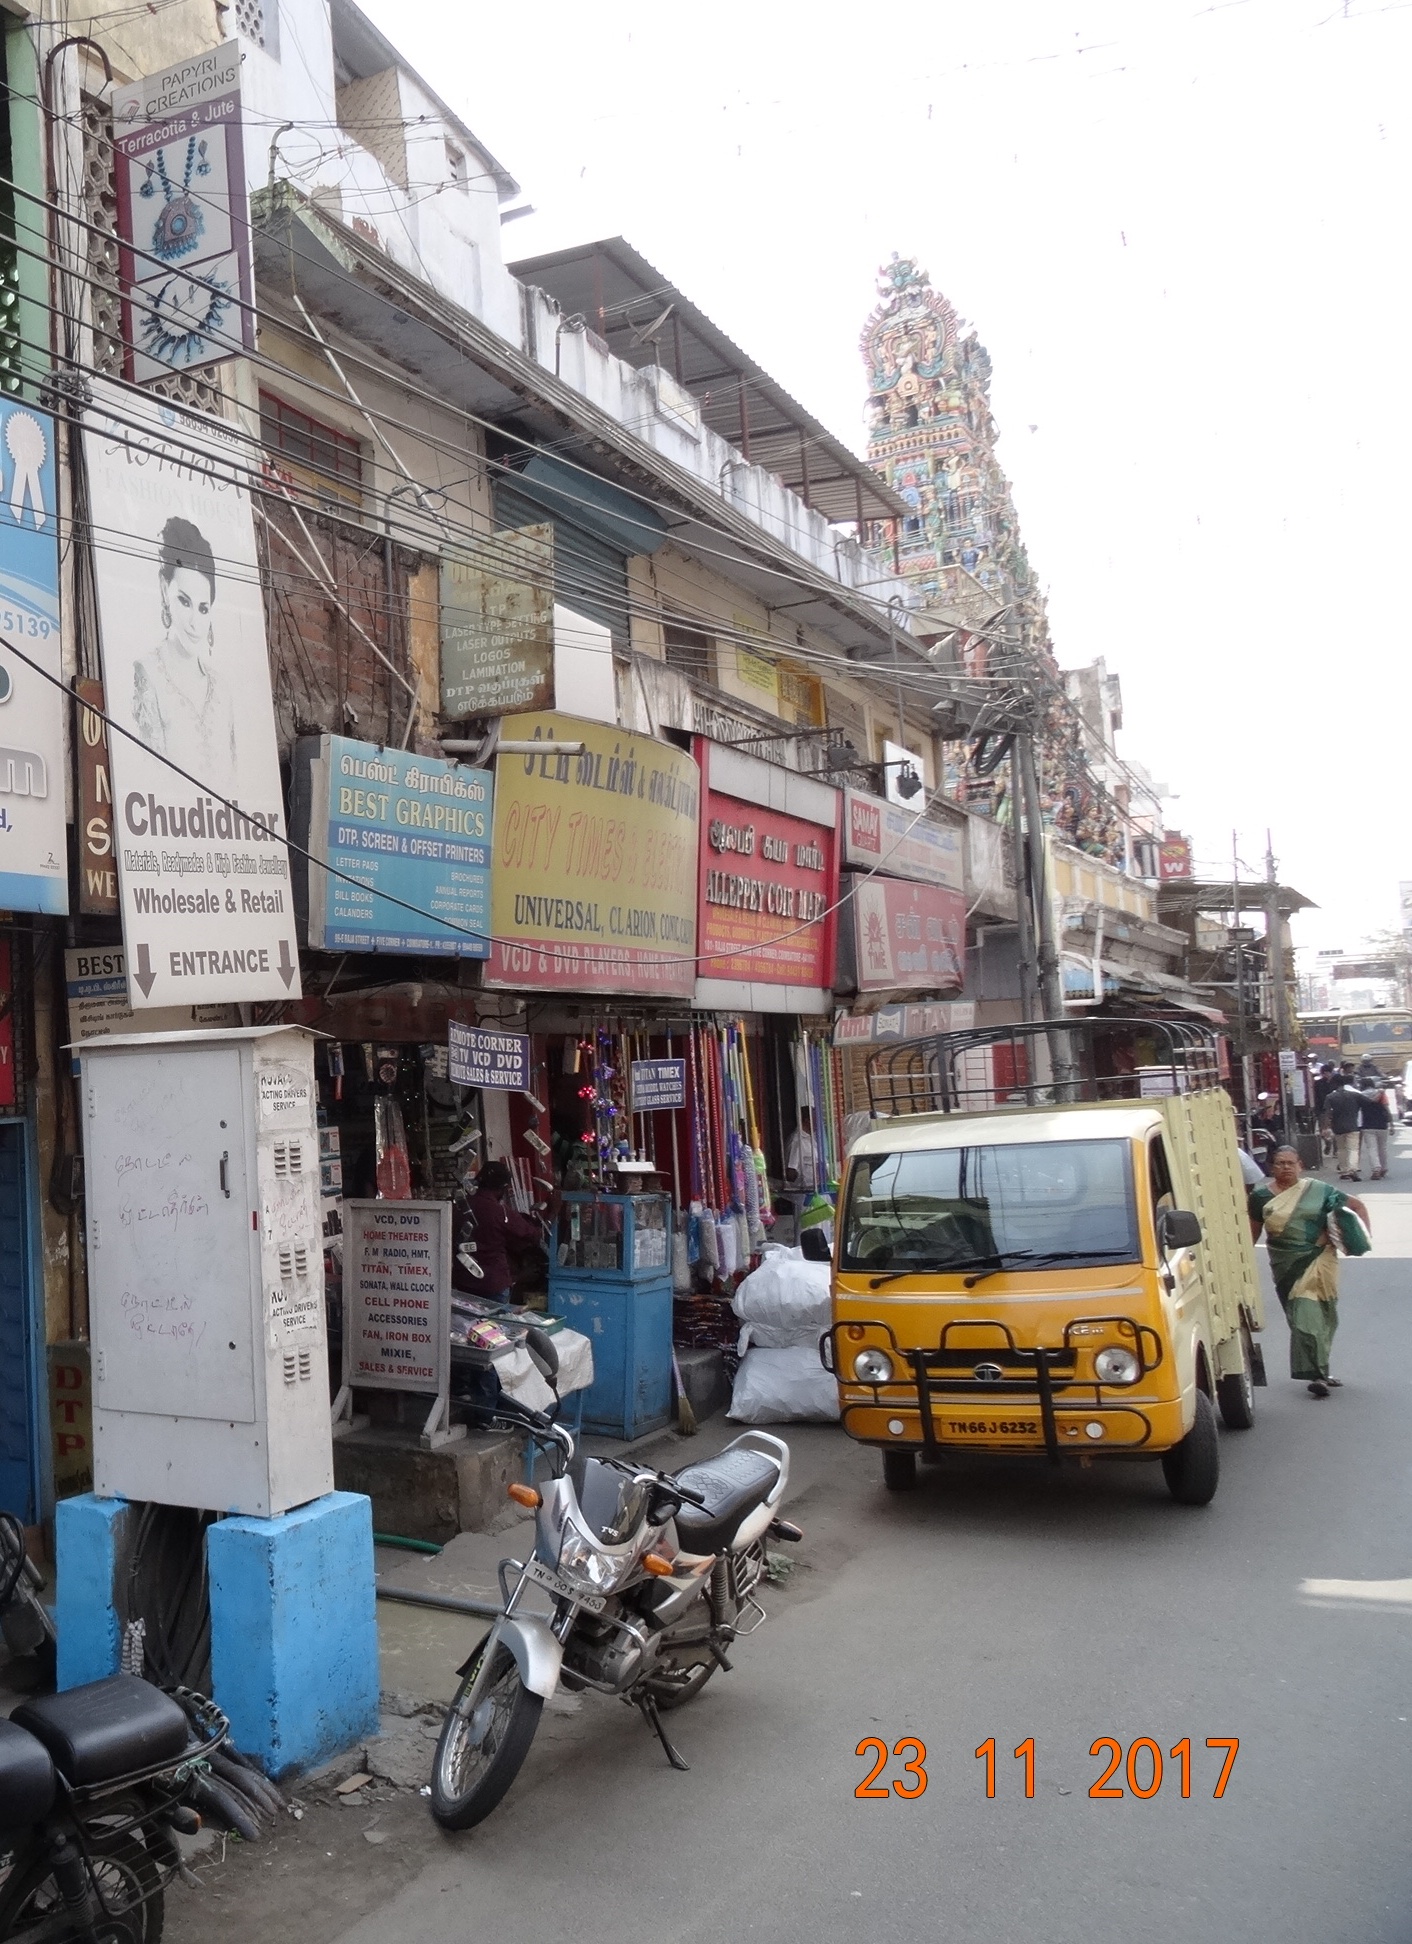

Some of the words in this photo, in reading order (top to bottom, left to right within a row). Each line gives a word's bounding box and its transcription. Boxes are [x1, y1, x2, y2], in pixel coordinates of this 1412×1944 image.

[161, 58, 218, 92] PAPYRI
[145, 68, 236, 116] CREATIONS
[191, 113, 200, 127] &
[204, 100, 235, 124] Jute
[445, 624, 475, 639] LASER
[457, 637, 487, 651] LASER
[474, 648, 511, 664] LOGOS
[462, 661, 526, 680] LAMINATION
[446, 685, 474, 698] DTP
[341, 755, 399, 785] பெஸ்ட்
[404, 766, 485, 802] கிராபிக்ஸ்
[125, 791, 278, 842] Chudidhar
[339, 787, 389, 821] BEST
[396, 798, 484, 837] GRAPHICS
[362, 831, 398, 852] SCREEN
[401, 838, 408, 853] &
[410, 839, 443, 858] OFFSET
[445, 844, 484, 864] PRINTERS
[502, 800, 561, 872] CITY
[566, 811, 626, 882] TIMES
[124, 850, 160, 876] Materials,
[162, 851, 204, 877] Readymades
[207, 853, 213, 873] &
[215, 852, 231, 878] High
[232, 853, 257, 875] Fashion
[259, 855, 288, 879] Jewellery
[336, 857, 361, 869] LETTER
[451, 872, 484, 884] BROCHURES
[335, 890, 349, 901] BILL
[351, 892, 373, 903] BOOKS
[435, 886, 458, 897] ANNUAL
[459, 887, 484, 899] REPORTS
[706, 869, 764, 912] ALLEPPEY
[768, 882, 794, 917] COIR
[133, 888, 219, 914] Wholesale
[225, 888, 237, 913] &
[240, 889, 284, 913] Retail
[431, 900, 464, 912] CORPORATE
[465, 902, 483, 913] CARDS
[335, 907, 373, 919] CALANDERS
[515, 894, 604, 938] UNIVERSAL,
[609, 906, 658, 944] CLARION,
[469, 918, 483, 929] SEAL
[77, 955, 124, 976] BEST
[169, 949, 270, 976] ENTRANCE
[501, 943, 532, 973] VCD
[538, 944, 547, 974] &
[554, 945, 579, 975] DVD
[584, 946, 635, 983] PLAYERS,
[911, 1008, 949, 1034] TITAN
[450, 1028, 476, 1048] REMOTE
[478, 1035, 522, 1053] CORNER
[460, 1048, 469, 1063] TV
[472, 1050, 491, 1067] VCD
[497, 1054, 522, 1070] DVD
[467, 1066, 483, 1083] SALES
[485, 1069, 490, 1083] &
[491, 1070, 522, 1086] SERVICE
[658, 1066, 680, 1079] TIMEX
[262, 1090, 282, 1099] ACTING
[284, 1089, 307, 1098] DRIVERS
[374, 1214, 397, 1226] VCD,
[400, 1215, 420, 1225] DVD
[363, 1230, 386, 1241] HOME
[388, 1231, 429, 1242] THEATERS
[383, 1248, 409, 1260] RADIO,
[411, 1249, 430, 1260] HMT,
[361, 1263, 392, 1276] TITAN,
[398, 1265, 431, 1277] TIMEX,
[360, 1280, 388, 1291] SONATA,
[390, 1281, 409, 1291] WALL
[411, 1282, 434, 1293] CLOCK
[294, 1301, 317, 1313] DRIVERS
[365, 1297, 390, 1307] CELL
[393, 1298, 429, 1310] PHONE
[283, 1315, 306, 1327] SERVICE
[368, 1312, 428, 1326] ACCESSORIES
[363, 1329, 382, 1340] FAN,
[386, 1330, 409, 1342] IRON
[412, 1332, 431, 1343] BOX
[381, 1347, 416, 1361] MIXIE,
[359, 1361, 385, 1373] SALES
[388, 1363, 394, 1373] &
[397, 1365, 433, 1377] SERVICE
[601, 1526, 619, 1537] TVS
